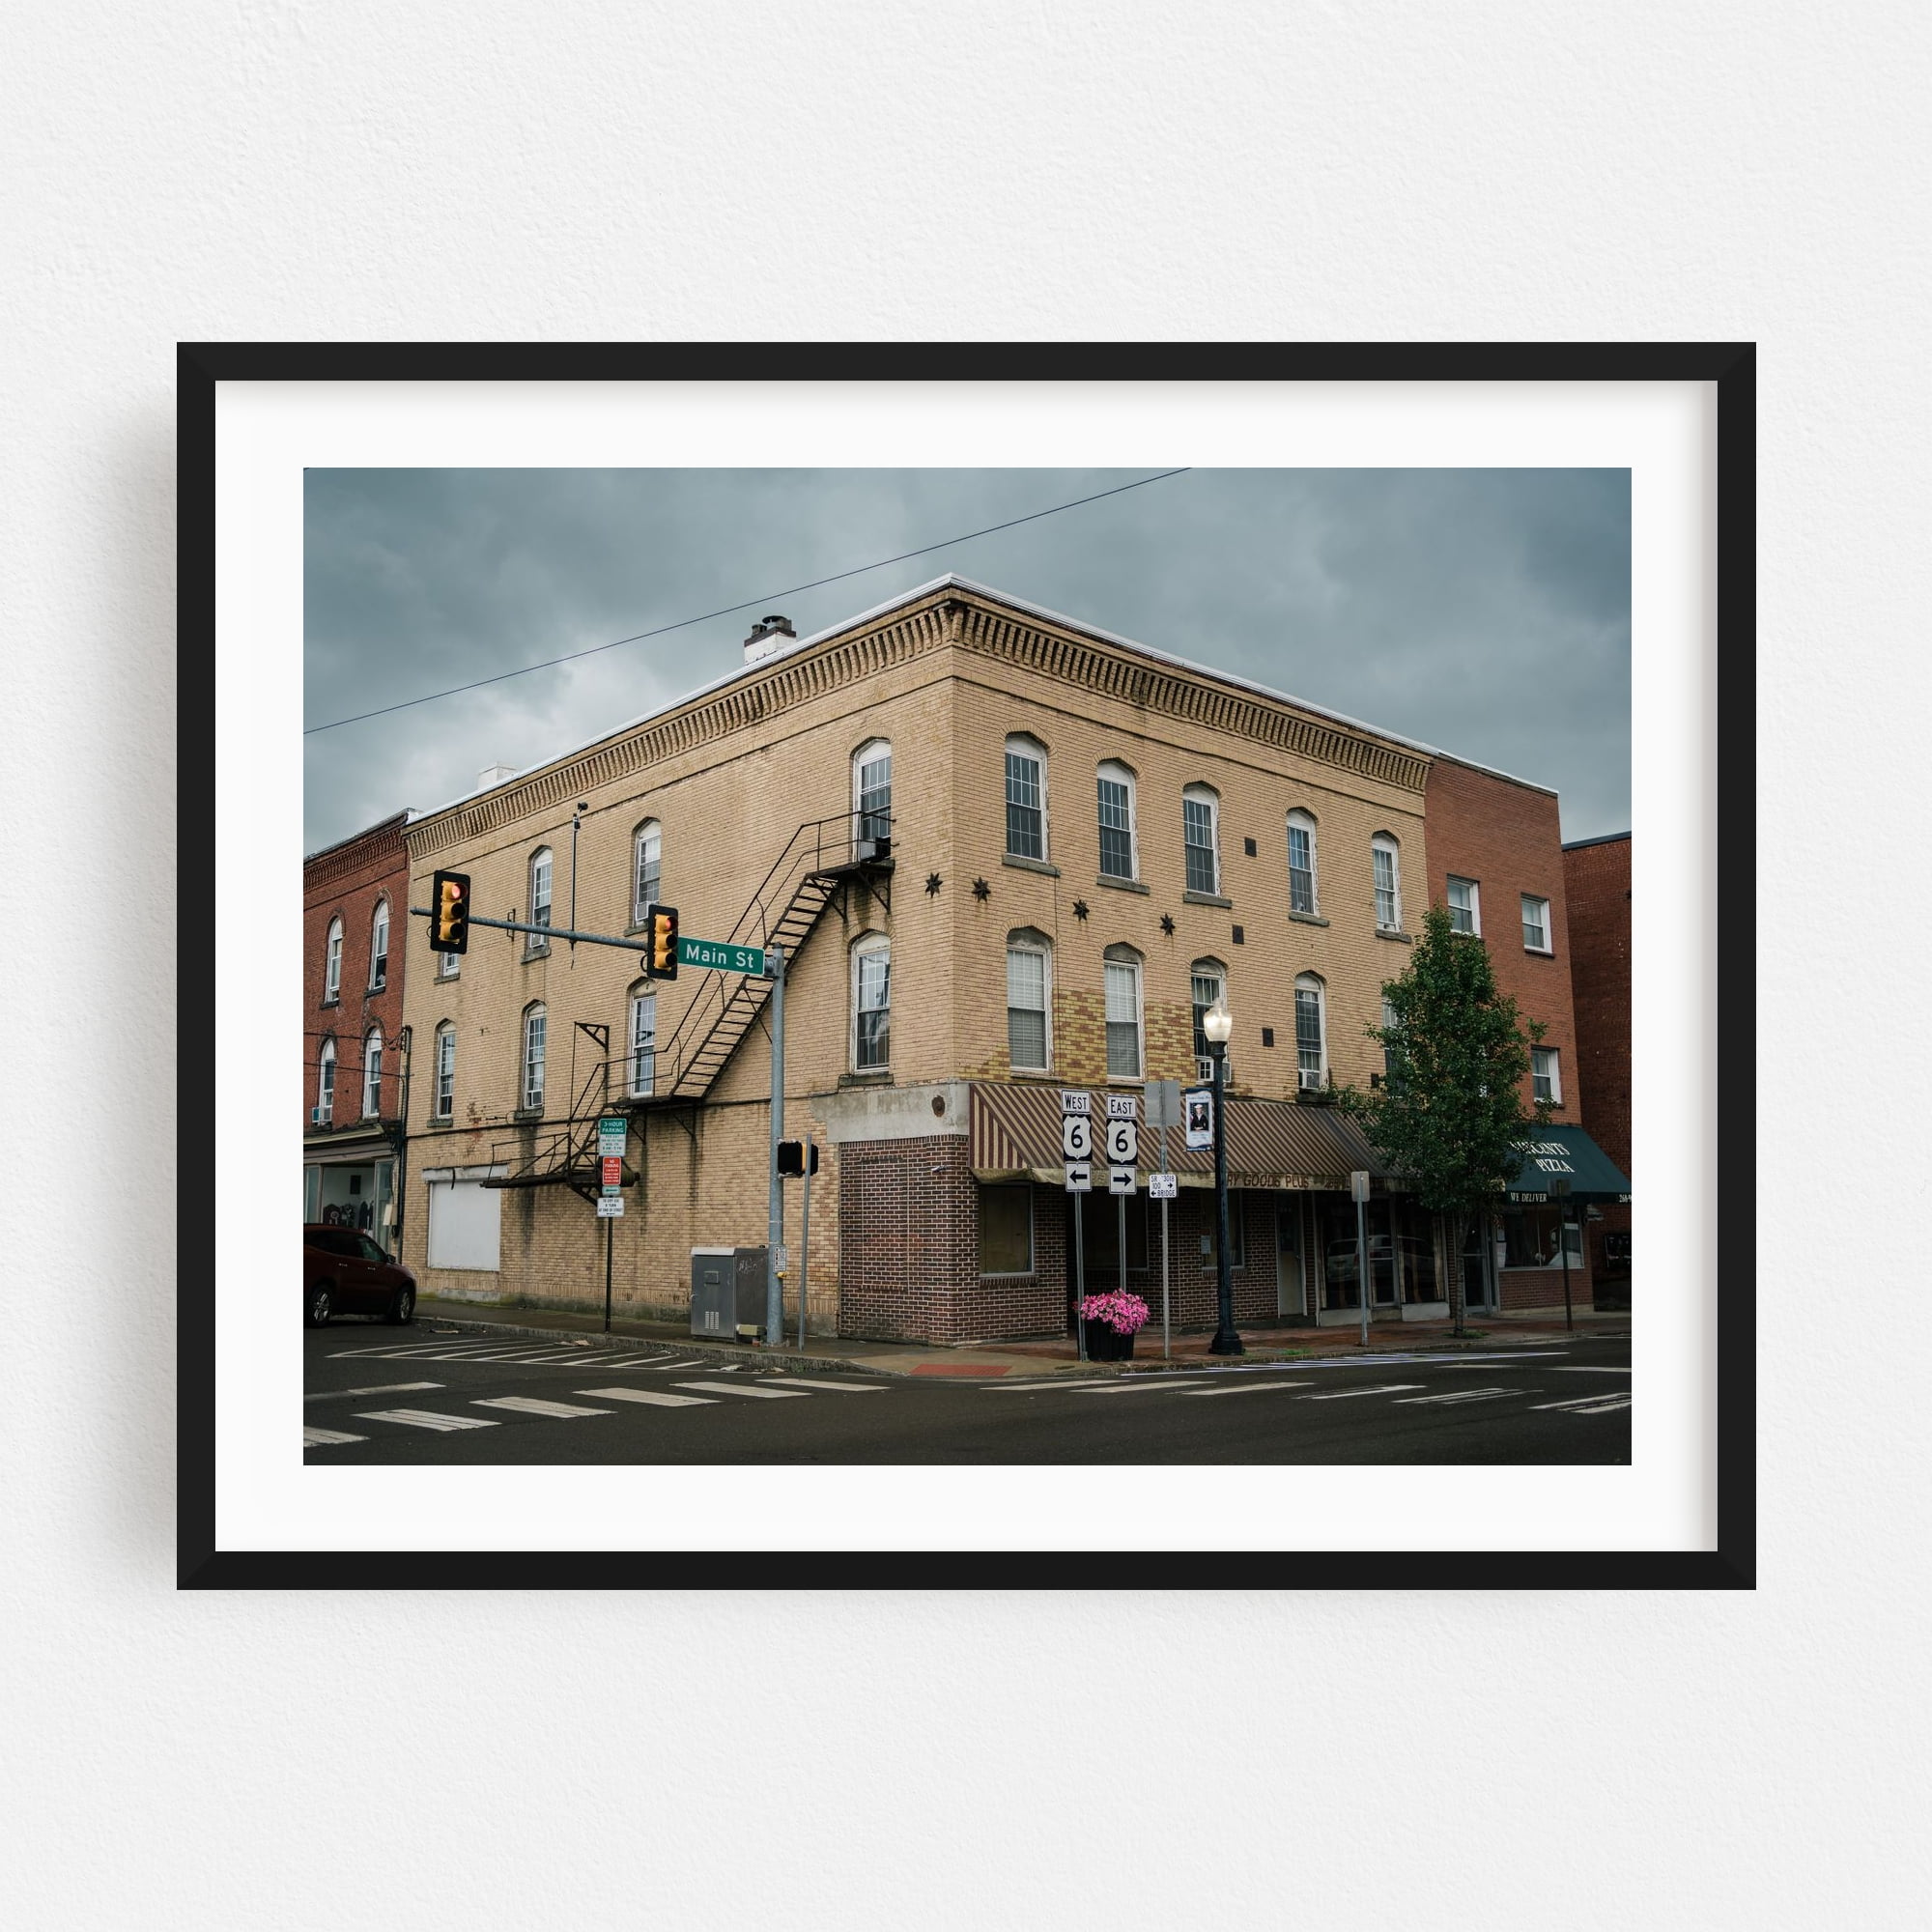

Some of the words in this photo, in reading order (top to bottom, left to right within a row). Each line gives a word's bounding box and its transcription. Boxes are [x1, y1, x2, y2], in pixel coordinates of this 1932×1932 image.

[686, 944, 726, 965] Main
[736, 952, 753, 969] St
[1065, 1094, 1087, 1109] WEST
[1110, 1099, 1132, 1114] EAST
[1071, 1124, 1083, 1149] 6
[1116, 1129, 1128, 1152] 6
[1535, 1158, 1576, 1173] PIZZA
[1243, 1174, 1281, 1187] GOODS
[1285, 1175, 1309, 1188] PLUS
[1510, 1192, 1520, 1202] WE
[1521, 1193, 1548, 1203] DELIVER
